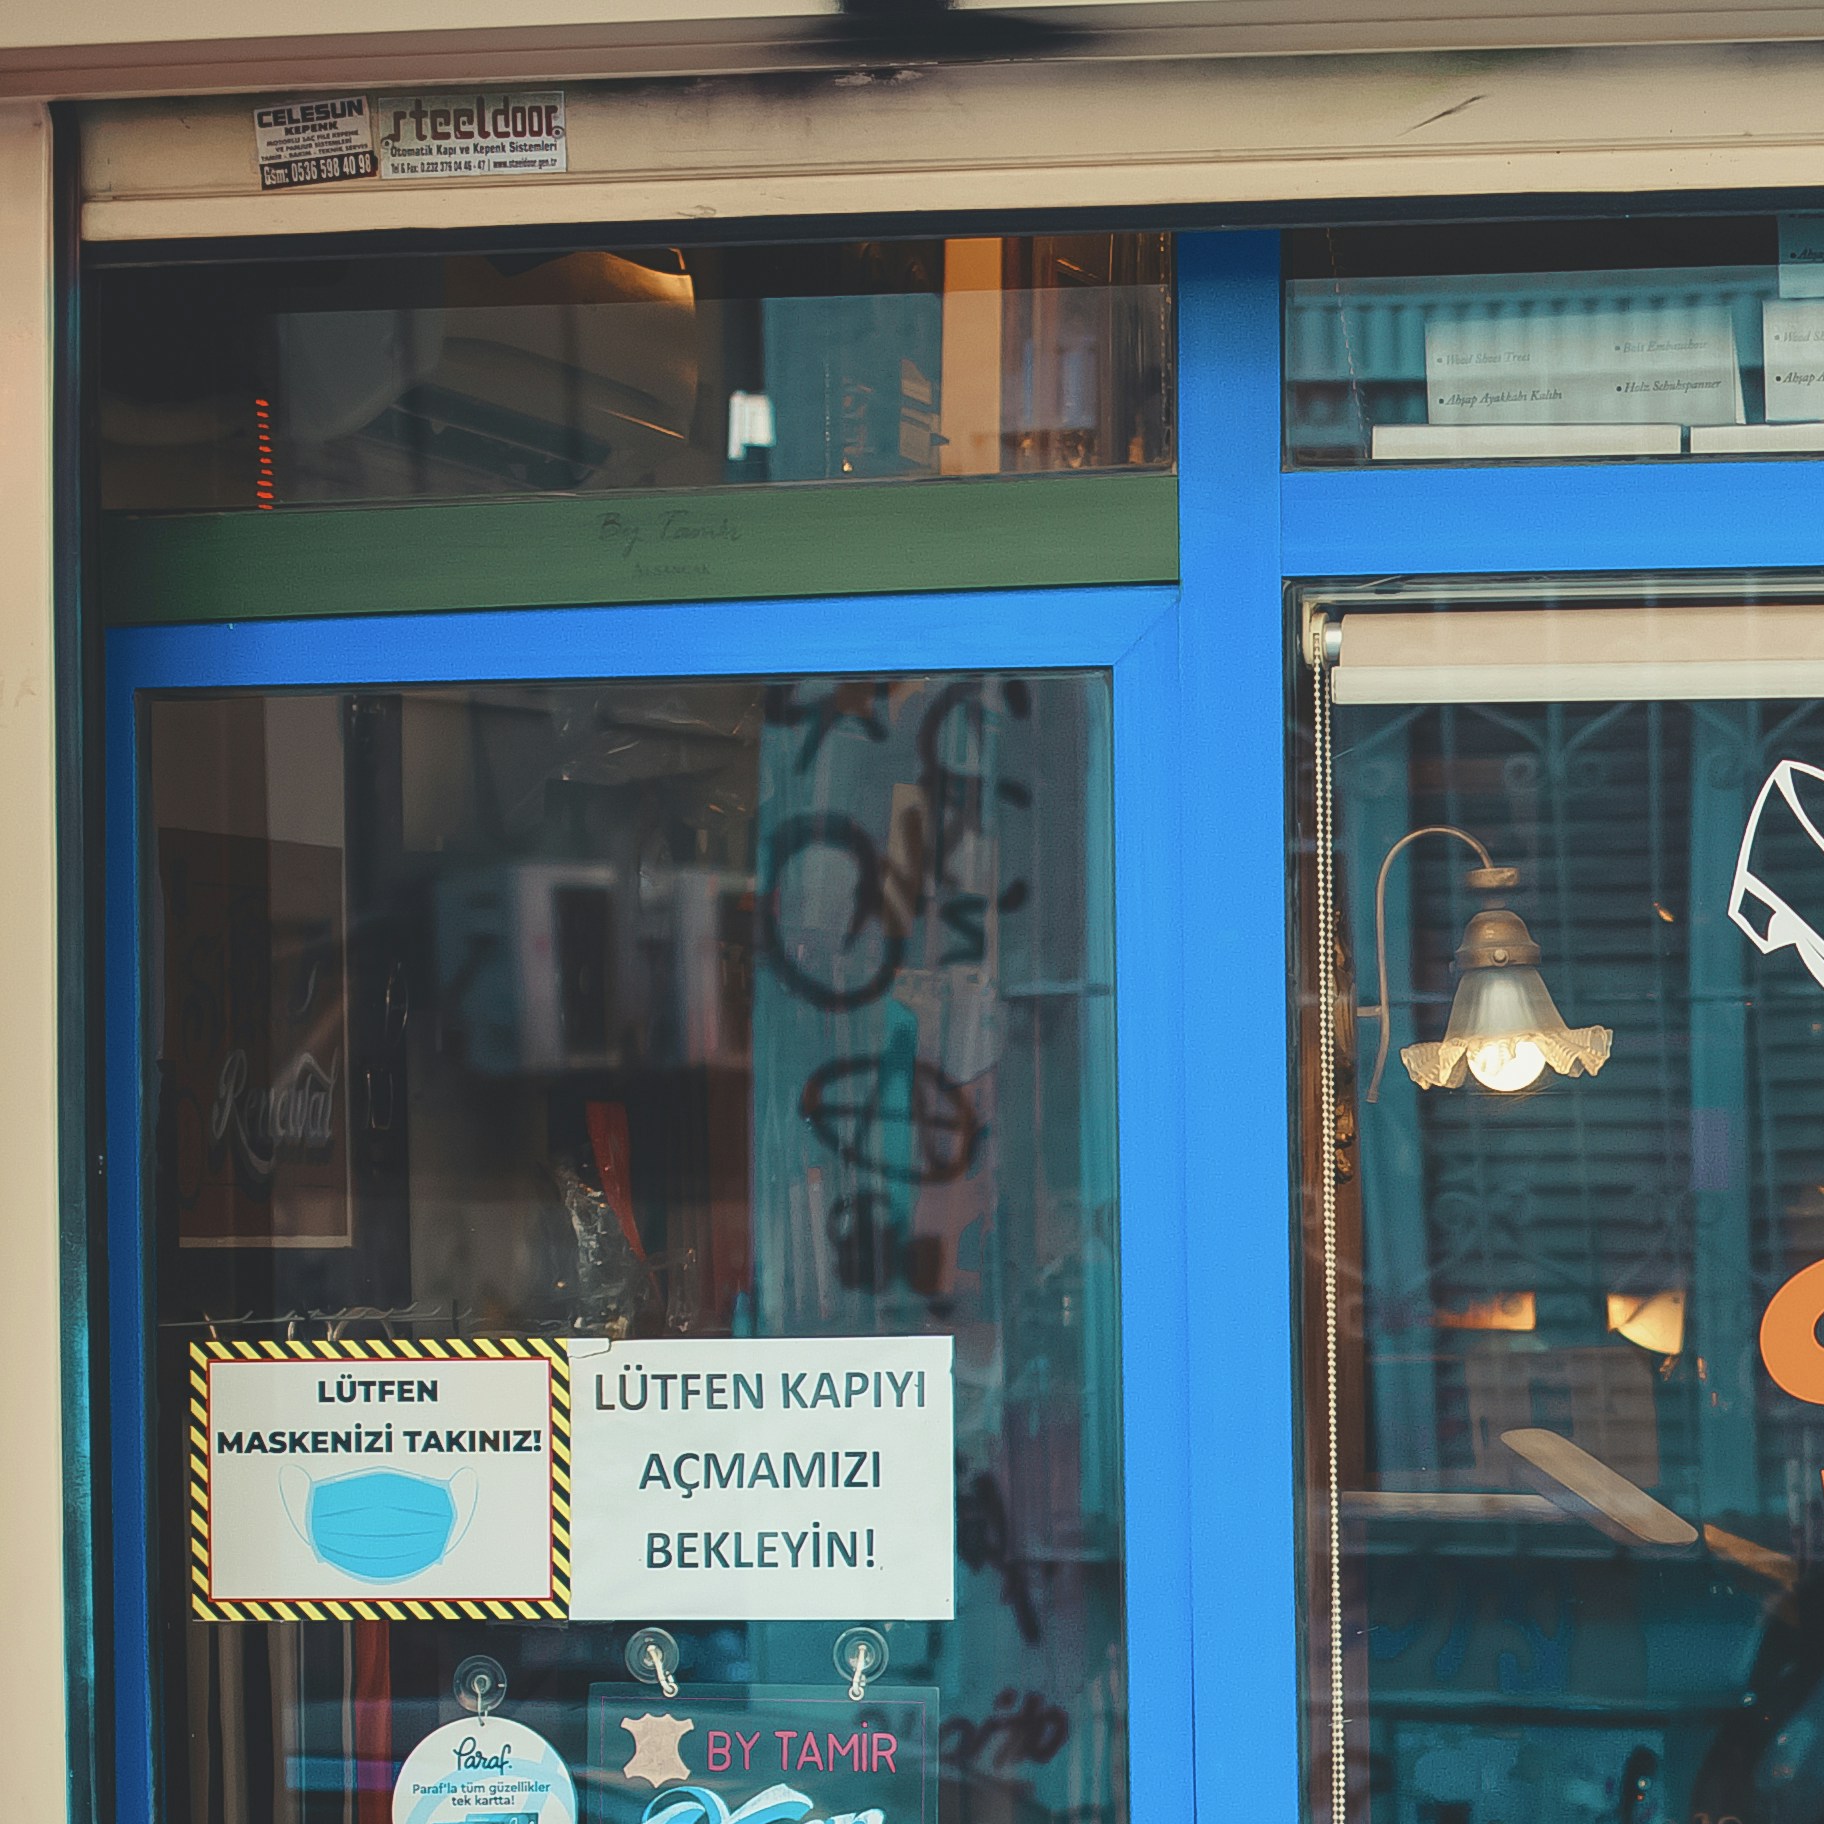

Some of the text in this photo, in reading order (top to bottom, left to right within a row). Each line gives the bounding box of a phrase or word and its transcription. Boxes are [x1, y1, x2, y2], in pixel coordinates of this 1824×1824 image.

[257, 98, 364, 129] CELESUN
[284, 120, 339, 136] KEPENK
[382, 95, 563, 144] steeldoor
[390, 145, 433, 158] Otomatik
[459, 145, 470, 155] ve
[473, 142, 507, 156] Kepenk
[509, 139, 558, 153] Sistemleri
[264, 153, 371, 185] Gsm: 0536 598 40 98
[317, 1374, 439, 1404] LÜTFEN
[596, 1363, 926, 1411] LÜTFEN KAPIYI
[217, 1424, 542, 1455] MASKENİZİ TAKINIZ!
[638, 1451, 881, 1500] AÇMAMIZI
[646, 1521, 875, 1569] BEKLEYİN!
[707, 1721, 898, 1774] BY TAMİR
[452, 1795, 516, 1806] tek kartta!
[461, 1781, 485, 1793] tüm
[489, 1780, 551, 1796] güzellikler
